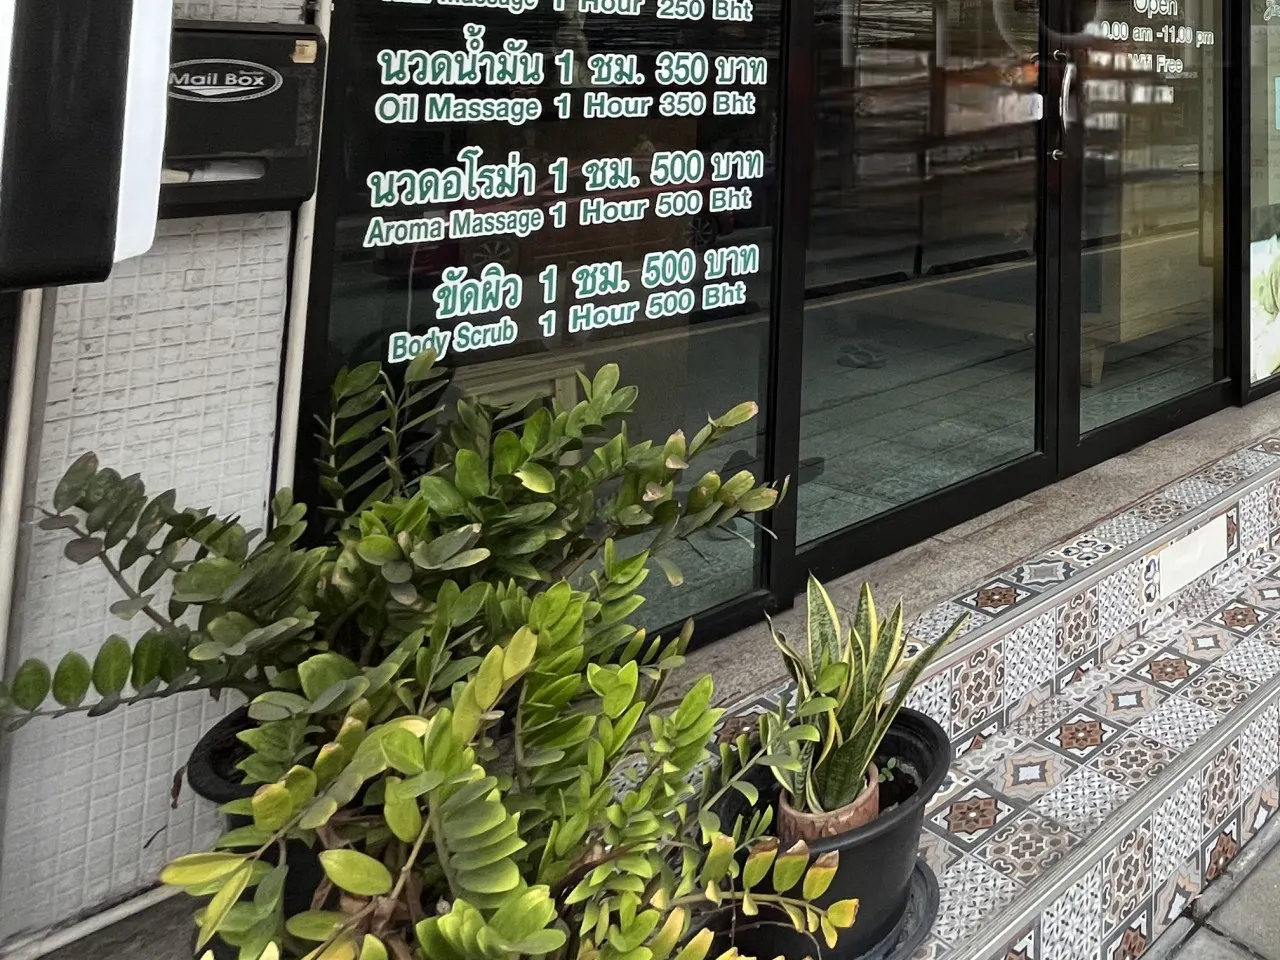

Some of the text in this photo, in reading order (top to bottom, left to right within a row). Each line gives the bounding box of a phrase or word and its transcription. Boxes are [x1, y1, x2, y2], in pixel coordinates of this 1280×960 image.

[378, 23, 767, 86] นวดน้ำมัน 1 ชม. 350 บาท
[1094, 21, 1129, 40] 0.00
[1133, 27, 1153, 42] am
[1196, 30, 1215, 48] pm
[1157, 55, 1183, 73] Free
[169, 73, 264, 85] Mail Box
[375, 91, 755, 124] Oil Massage 1 Hour 350 Bht
[367, 146, 764, 207] นวดอโรม่า 1 ชม. 500 บาท
[363, 187, 752, 248] Aroma Massage 1 Hour 500 Bht
[433, 244, 759, 320] ขัดผิว 1 ชม. 500 บาท
[388, 285, 746, 363] Body Scrub 1 Hour 500 Bht
